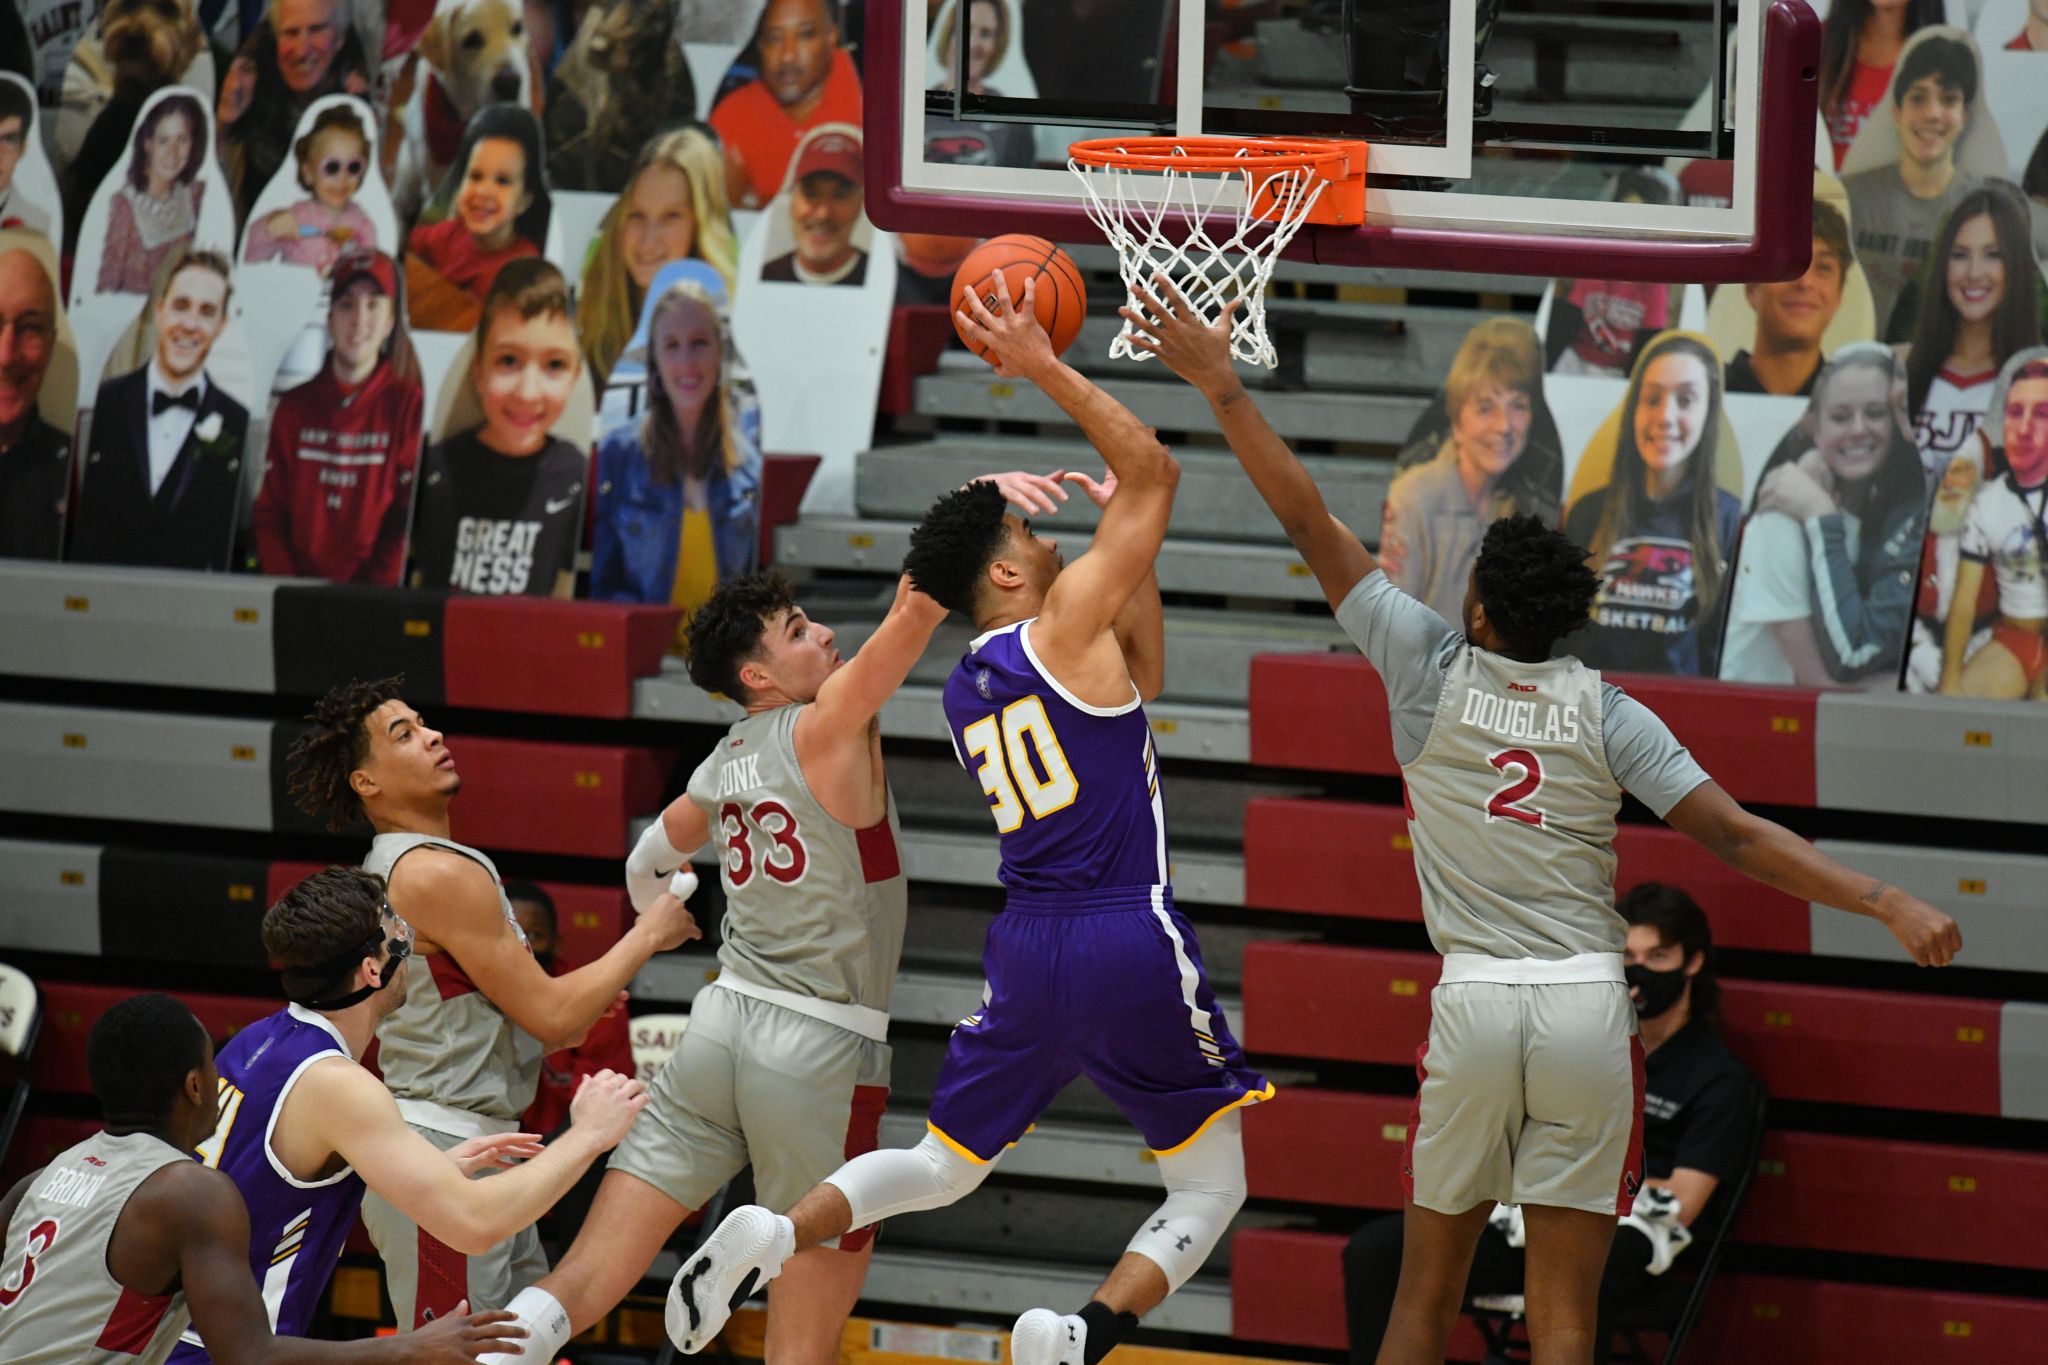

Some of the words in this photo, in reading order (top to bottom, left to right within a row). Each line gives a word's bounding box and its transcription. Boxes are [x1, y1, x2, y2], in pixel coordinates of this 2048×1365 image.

[457, 516, 543, 557] GREAT
[449, 552, 533, 595] NESS
[1460, 687, 1580, 743] DOUGLAS
[963, 694, 1080, 834] 30
[1484, 747, 1547, 829] 2
[719, 797, 810, 890] 33
[38, 1166, 107, 1208] BROWN
[0, 1216, 61, 1311] 3
